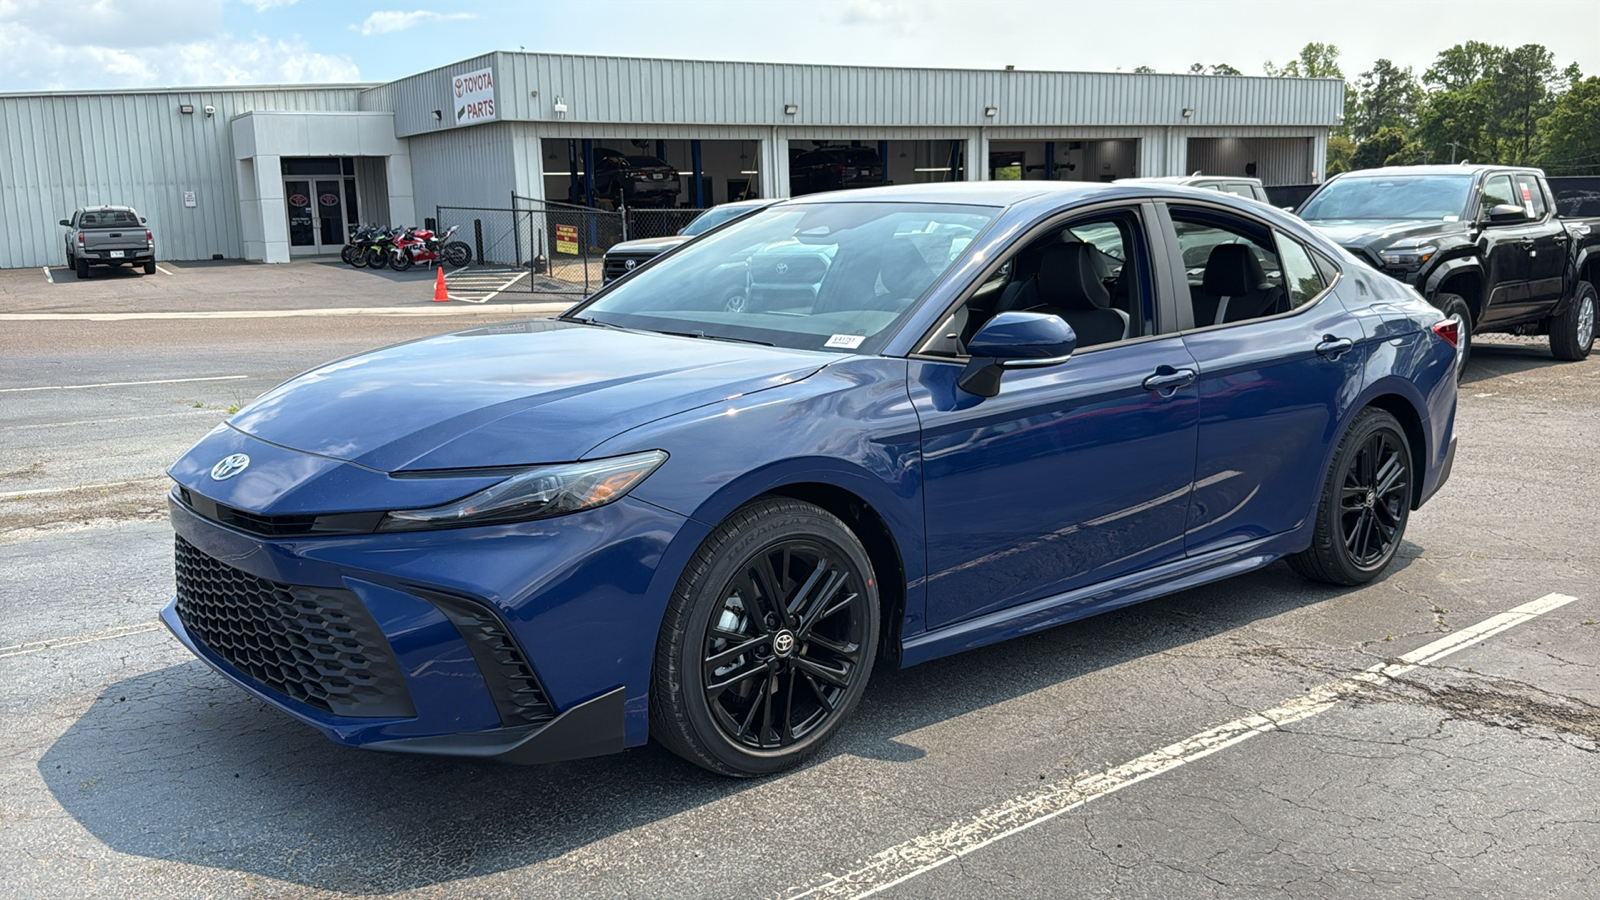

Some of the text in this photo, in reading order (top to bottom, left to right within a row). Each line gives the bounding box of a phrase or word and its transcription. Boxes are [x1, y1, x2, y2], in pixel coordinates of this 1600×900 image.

[463, 72, 493, 94] TOYOTA
[467, 99, 494, 120] PARTS
[723, 517, 801, 562] TURANZA
